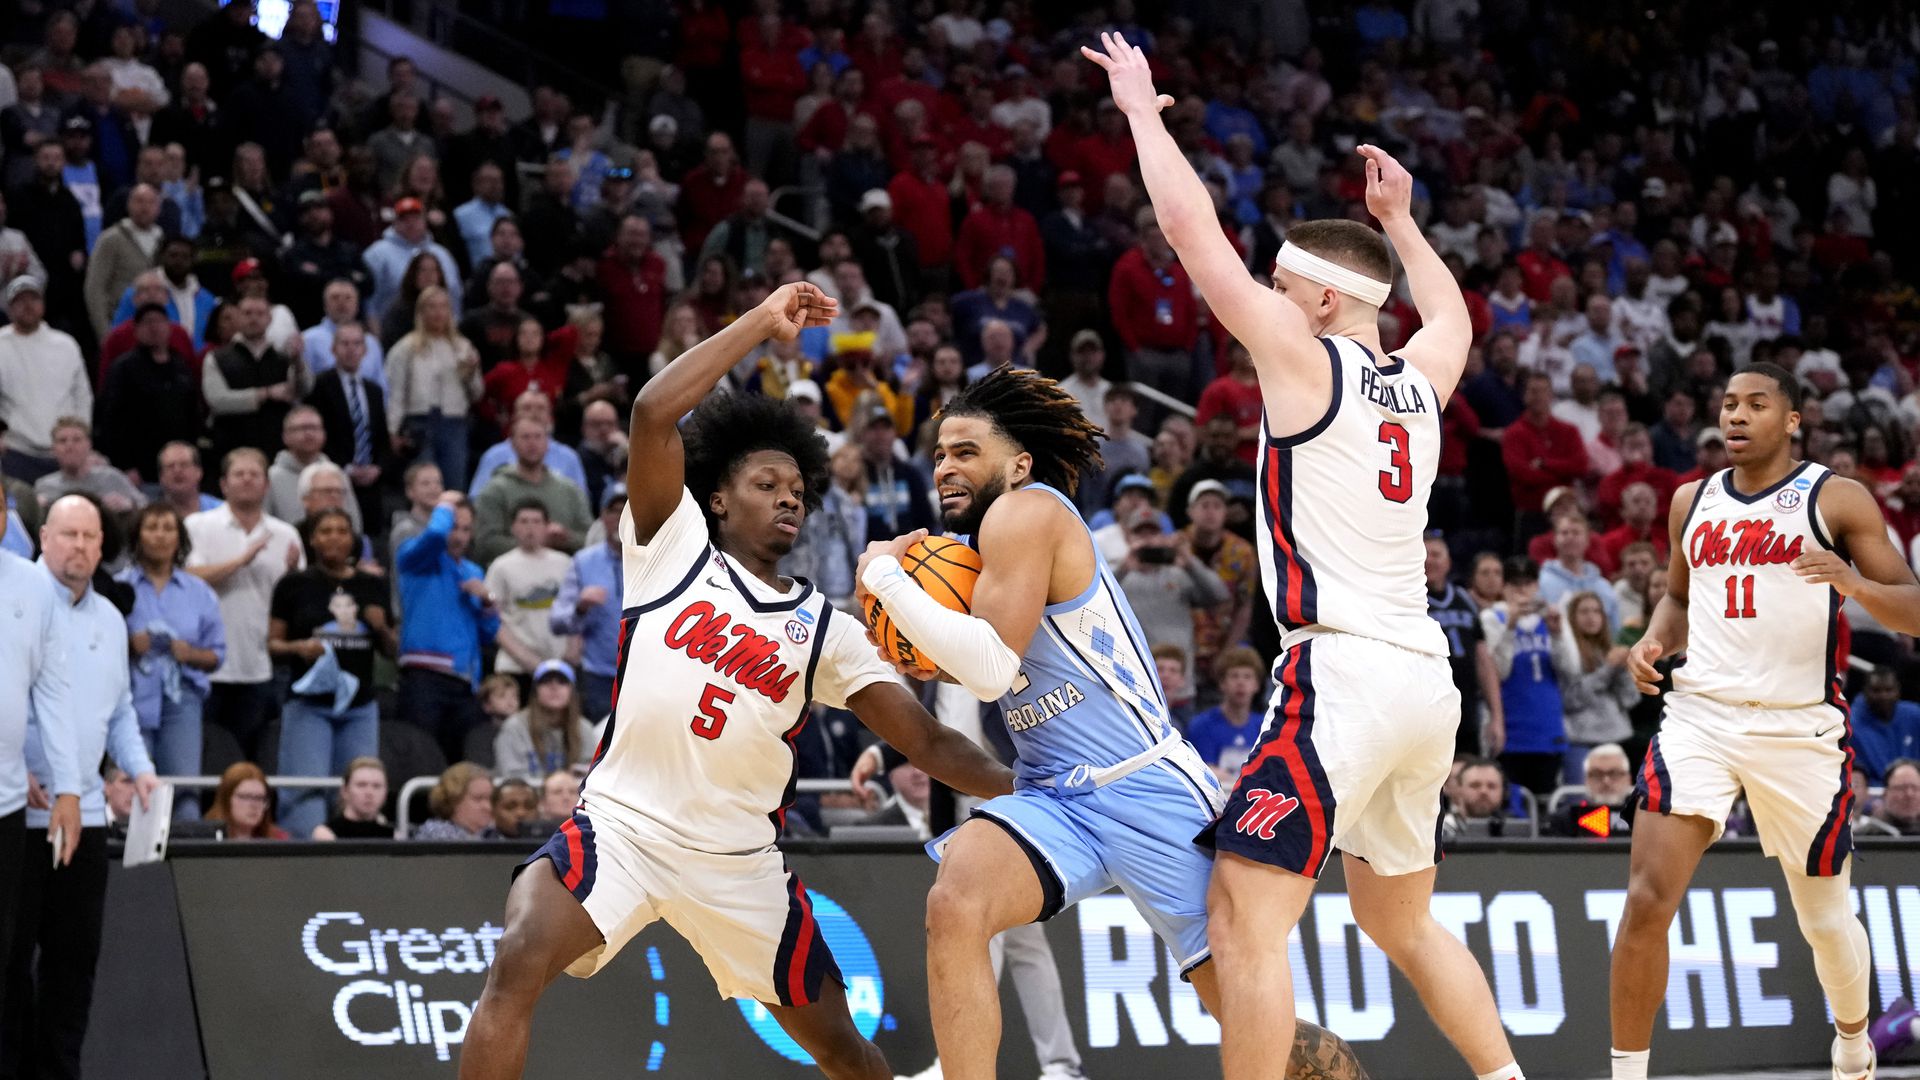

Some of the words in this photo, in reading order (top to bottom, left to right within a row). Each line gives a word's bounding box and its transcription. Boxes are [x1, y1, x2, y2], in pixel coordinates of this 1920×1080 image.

[1378, 421, 1413, 504] 3
[1779, 490, 1799, 507] SEC
[1690, 520, 1731, 568] Ole
[1731, 519, 1804, 566] Miss
[1725, 575, 1757, 618] 11
[664, 601, 731, 664] Ole
[714, 624, 800, 703] Miss
[785, 620, 809, 645] SEC
[690, 682, 736, 740] 5
[1006, 681, 1086, 732] AROLINA
[1236, 788, 1299, 840] M
[302, 911, 505, 976] Great
[332, 979, 479, 1061] Clip
